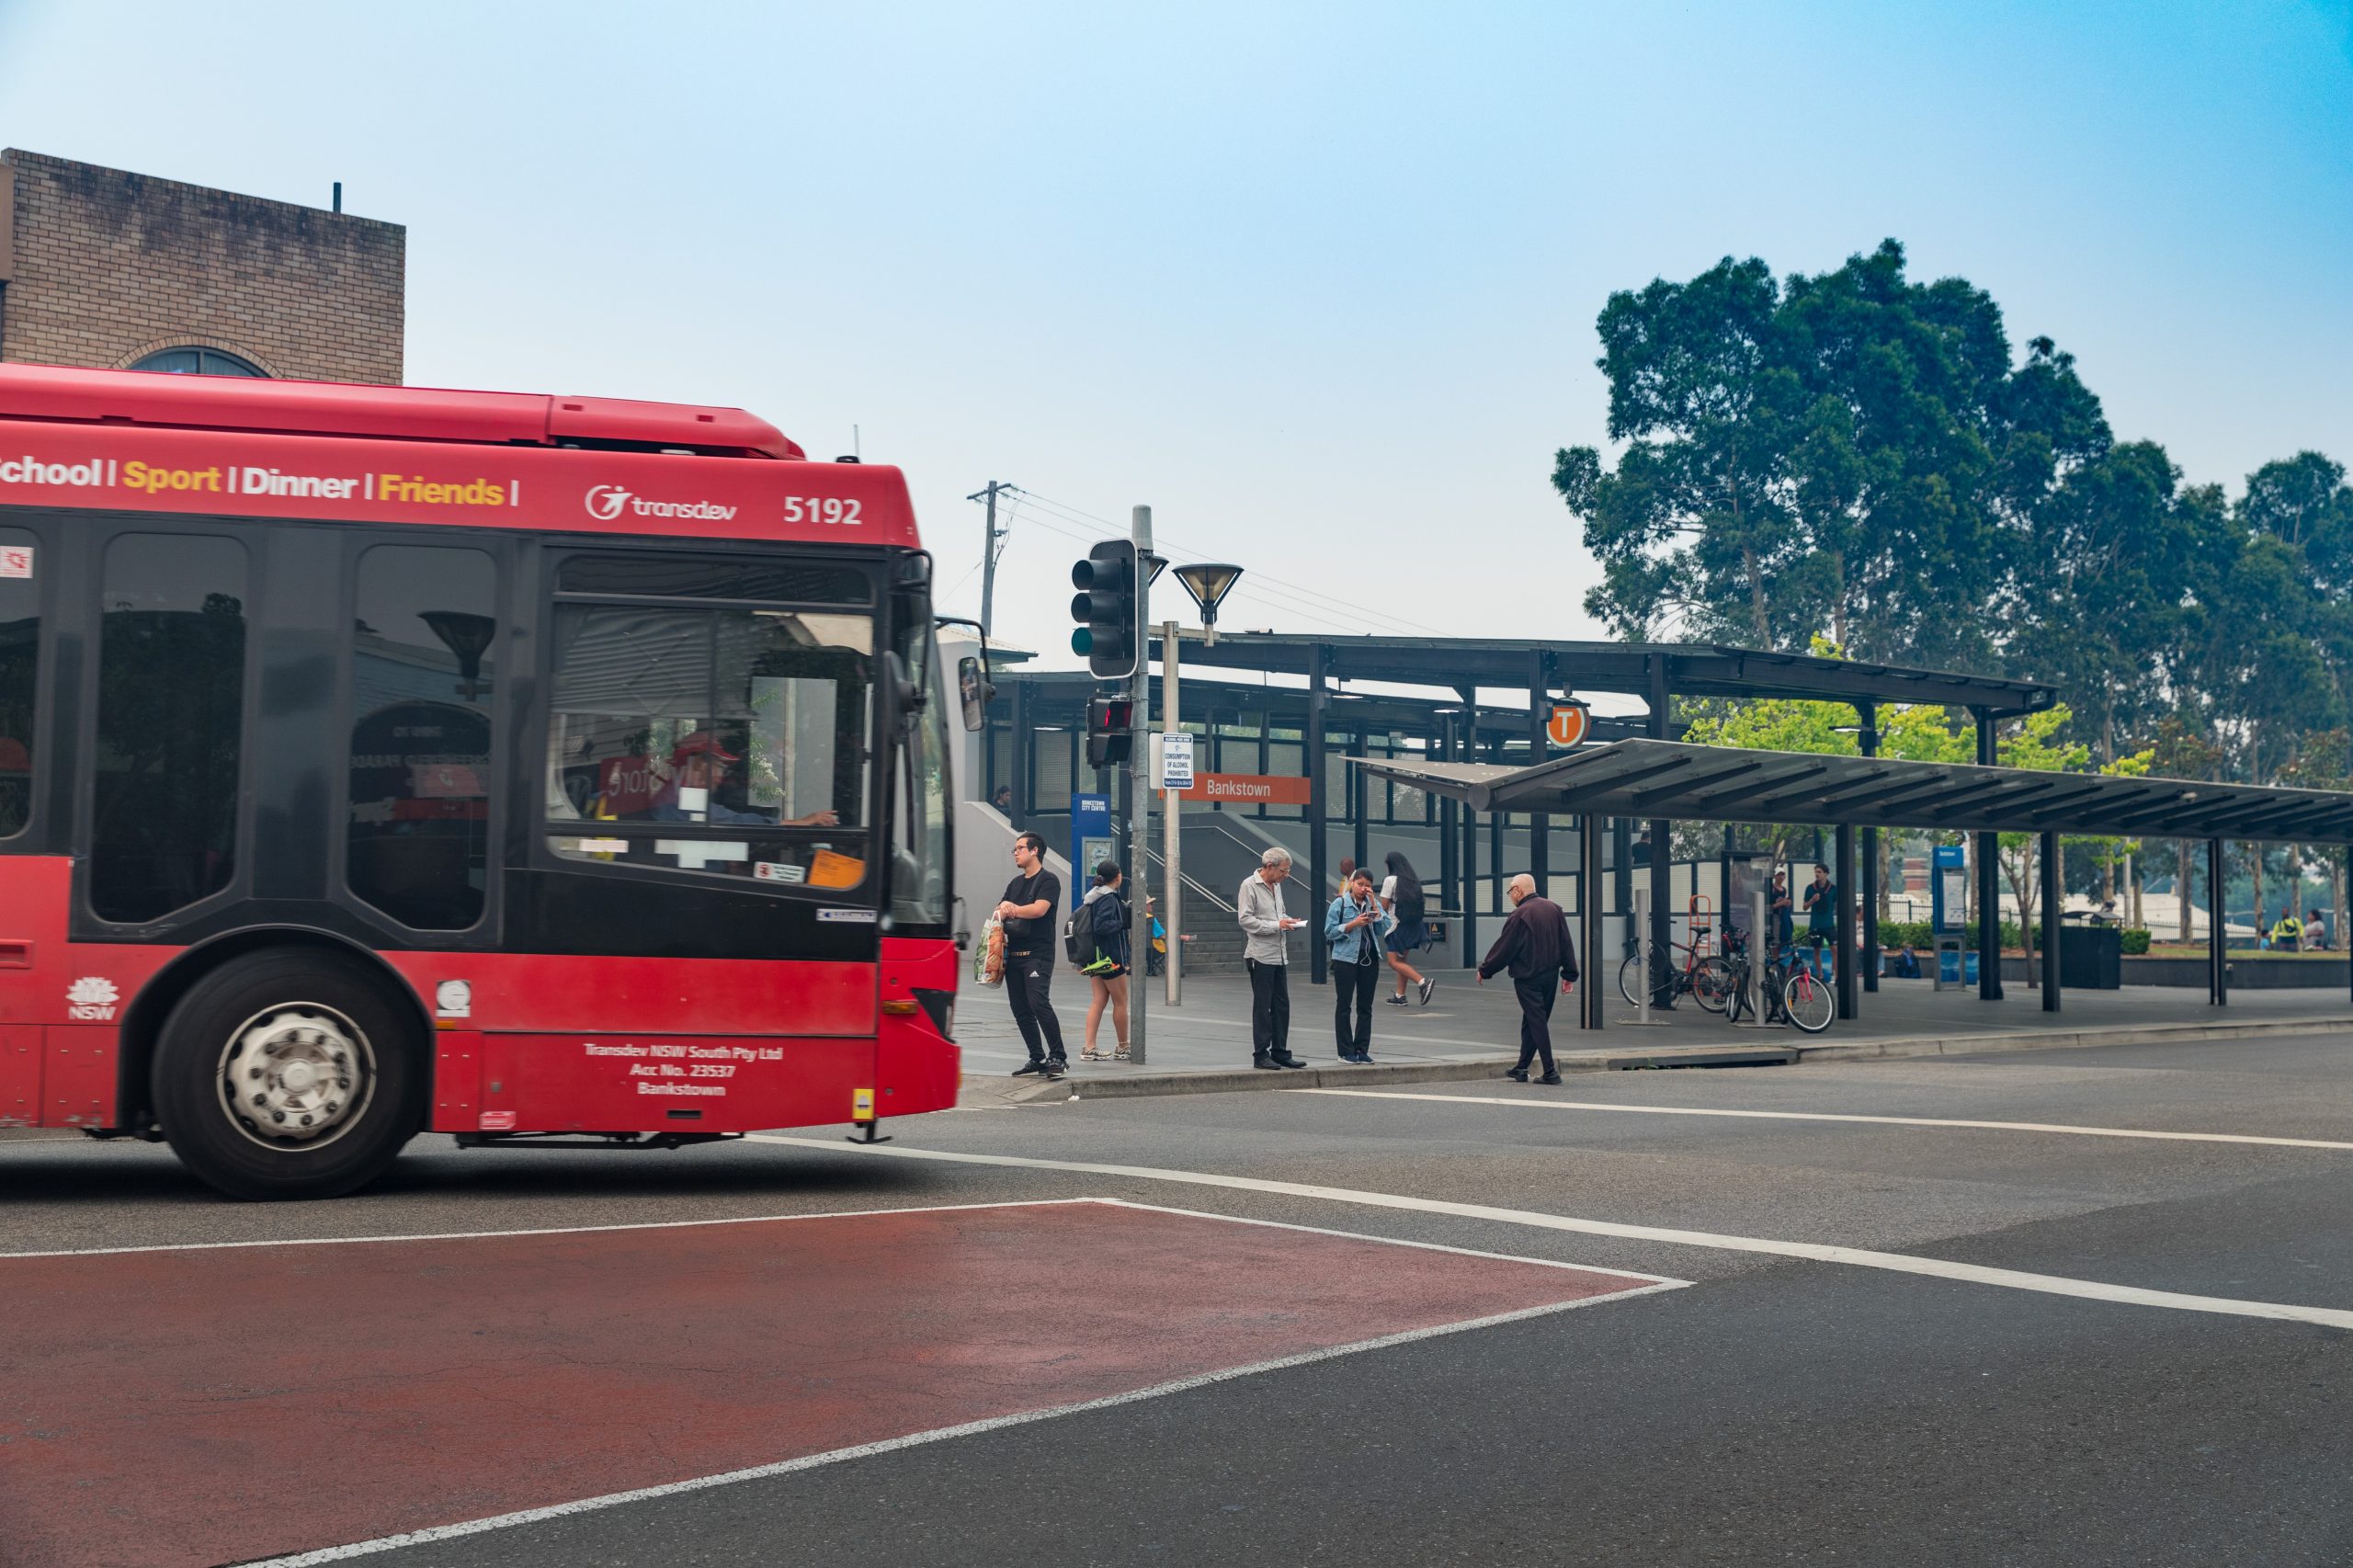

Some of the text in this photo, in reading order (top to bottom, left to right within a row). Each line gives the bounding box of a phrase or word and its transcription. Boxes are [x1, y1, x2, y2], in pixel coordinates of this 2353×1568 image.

[0, 455, 505, 506] chool Sport Dinner Friends
[631, 496, 737, 520] transdev
[783, 496, 862, 525] 5192
[1556, 711, 1574, 738] T
[1207, 779, 1270, 797] Bankstown
[68, 1006, 117, 1020] NSW
[584, 1043, 784, 1062] Transdev NSW South Pty Ltd
[630, 1063, 736, 1078] Acc No. 23537
[637, 1081, 726, 1096] Bankstown
